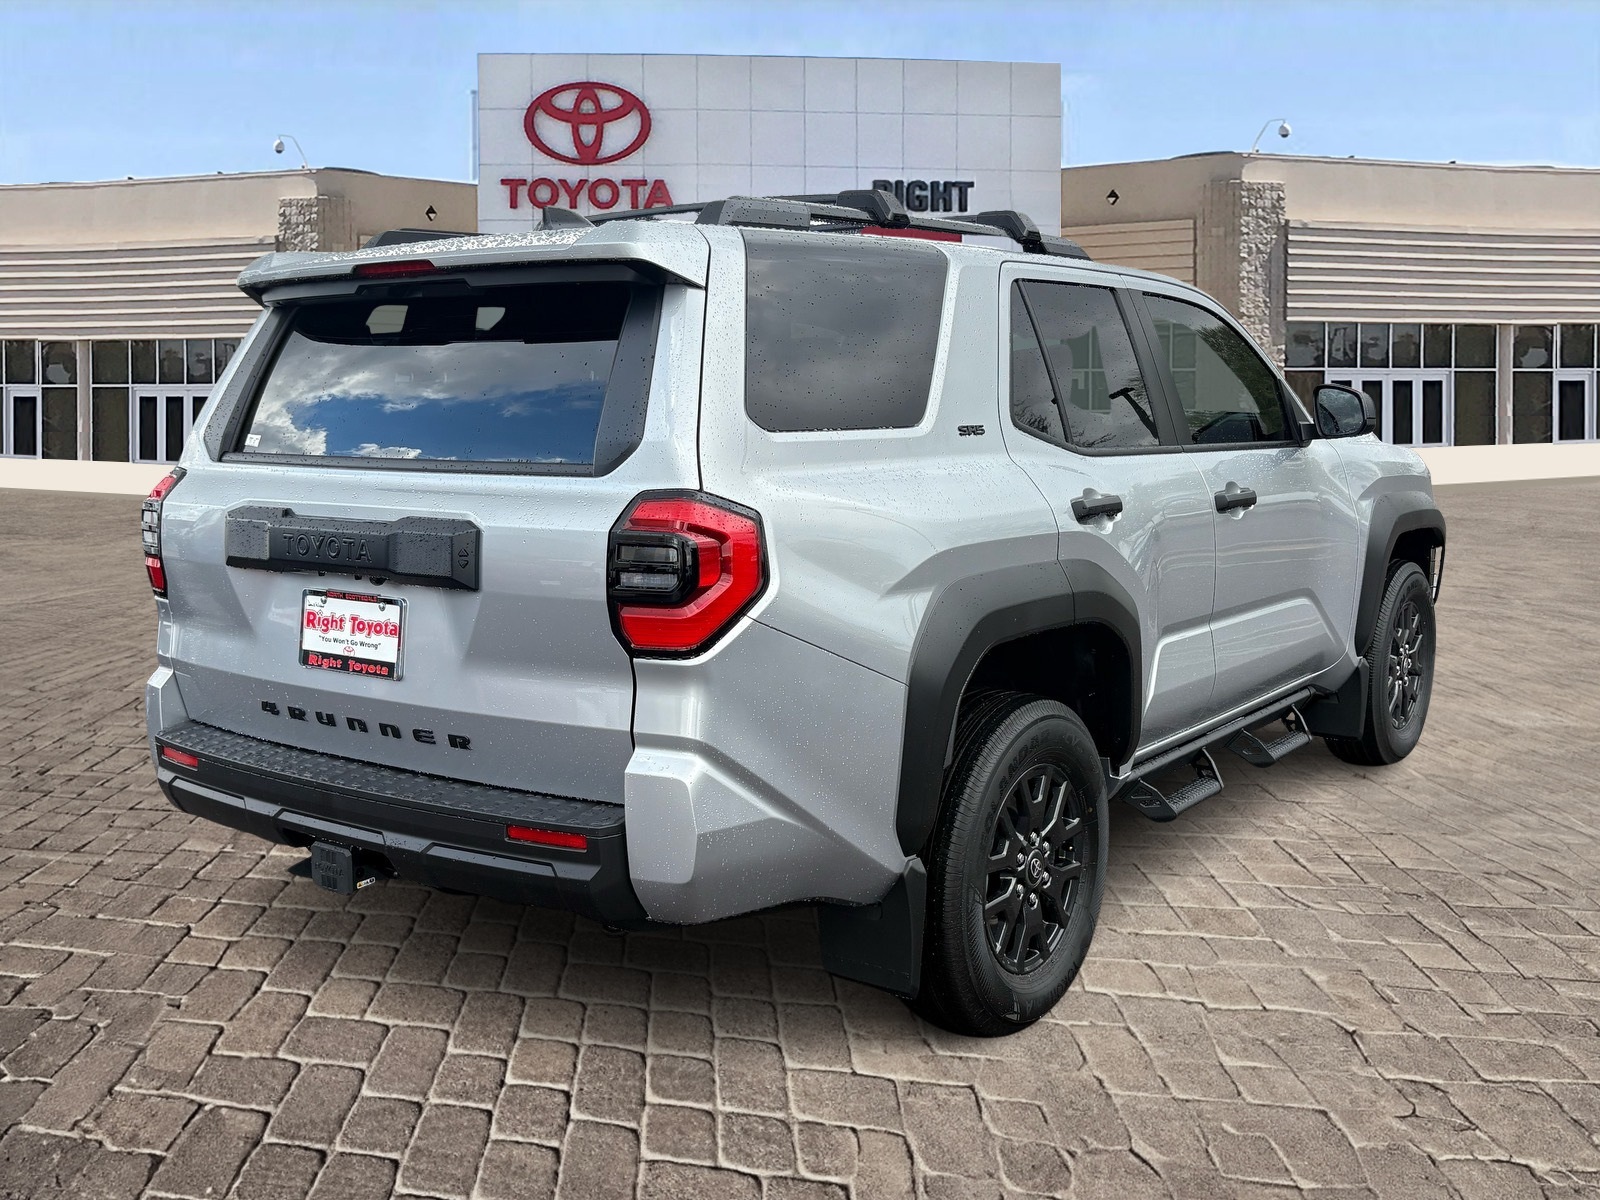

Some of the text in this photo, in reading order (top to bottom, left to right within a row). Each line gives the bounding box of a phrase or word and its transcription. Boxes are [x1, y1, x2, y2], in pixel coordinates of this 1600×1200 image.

[500, 177, 674, 210] TOYOTA
[957, 424, 986, 437] SR5
[282, 532, 373, 563] TOYOTA
[304, 609, 399, 638] Right Toyota
[350, 639, 359, 647] Go
[308, 654, 389, 675] Right Toyota
